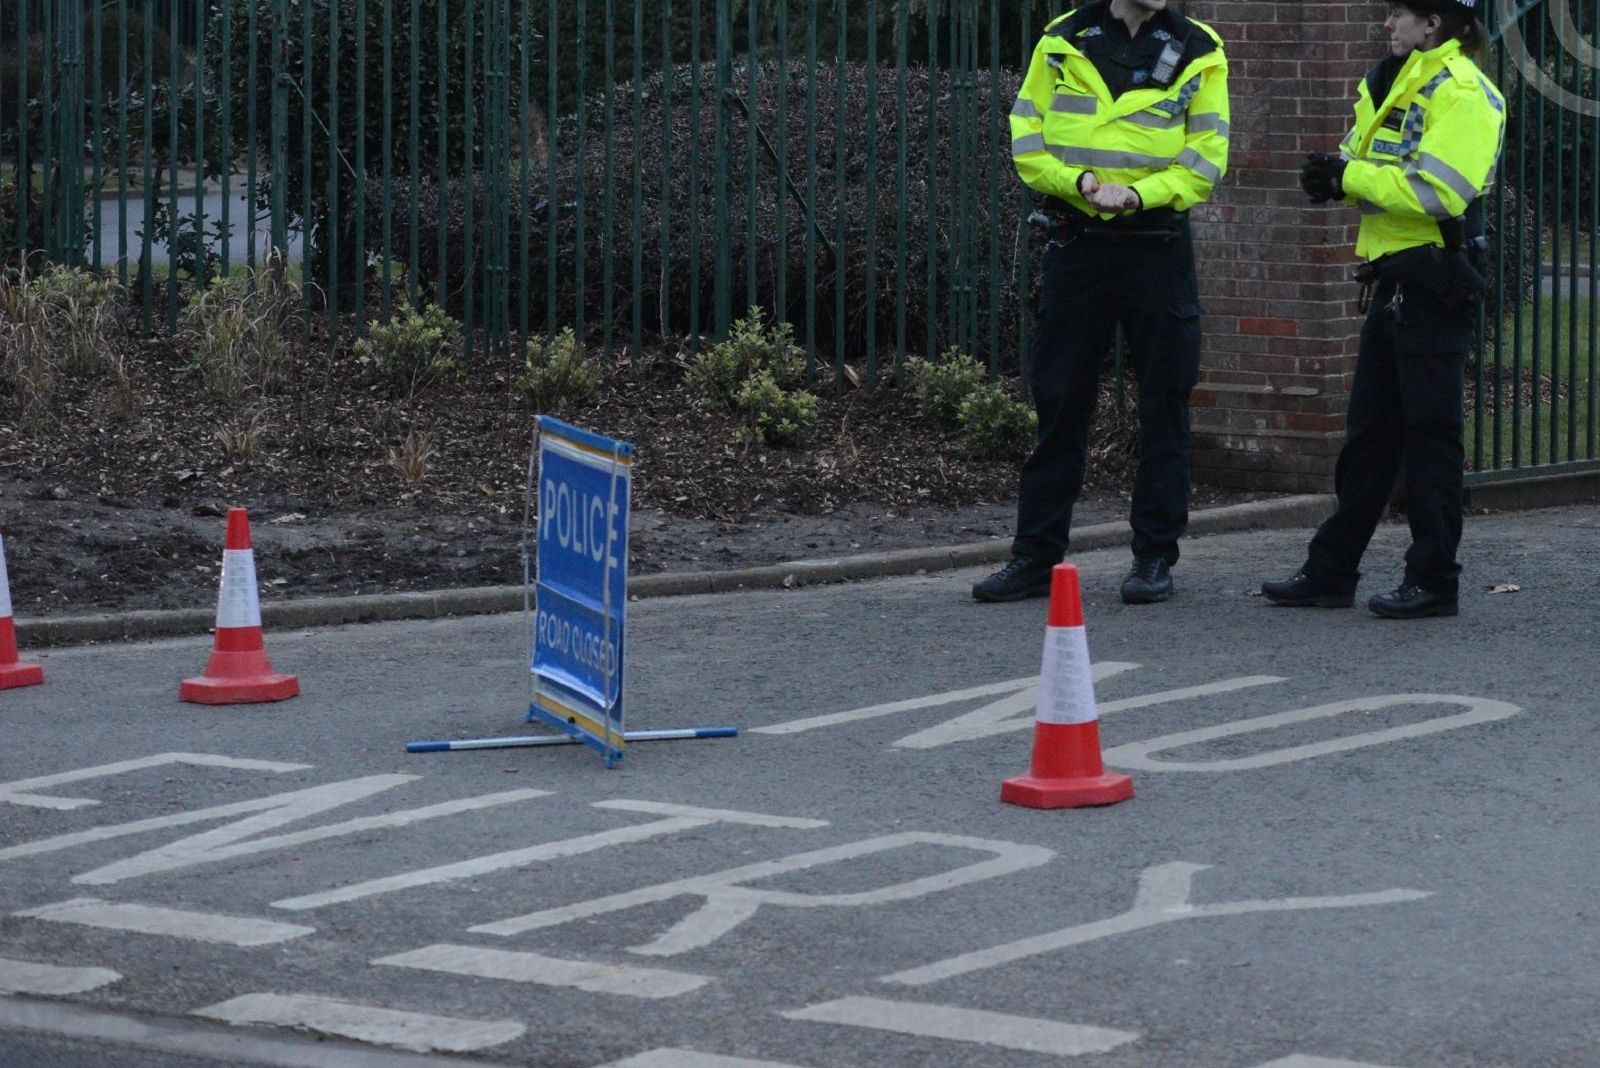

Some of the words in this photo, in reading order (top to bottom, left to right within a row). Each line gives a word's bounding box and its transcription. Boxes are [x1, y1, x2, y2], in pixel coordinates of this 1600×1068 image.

[544, 479, 619, 569] POLICE
[539, 611, 570, 653] ROAD
[572, 625, 616, 677] CLOSED
[746, 661, 1524, 773] NO
